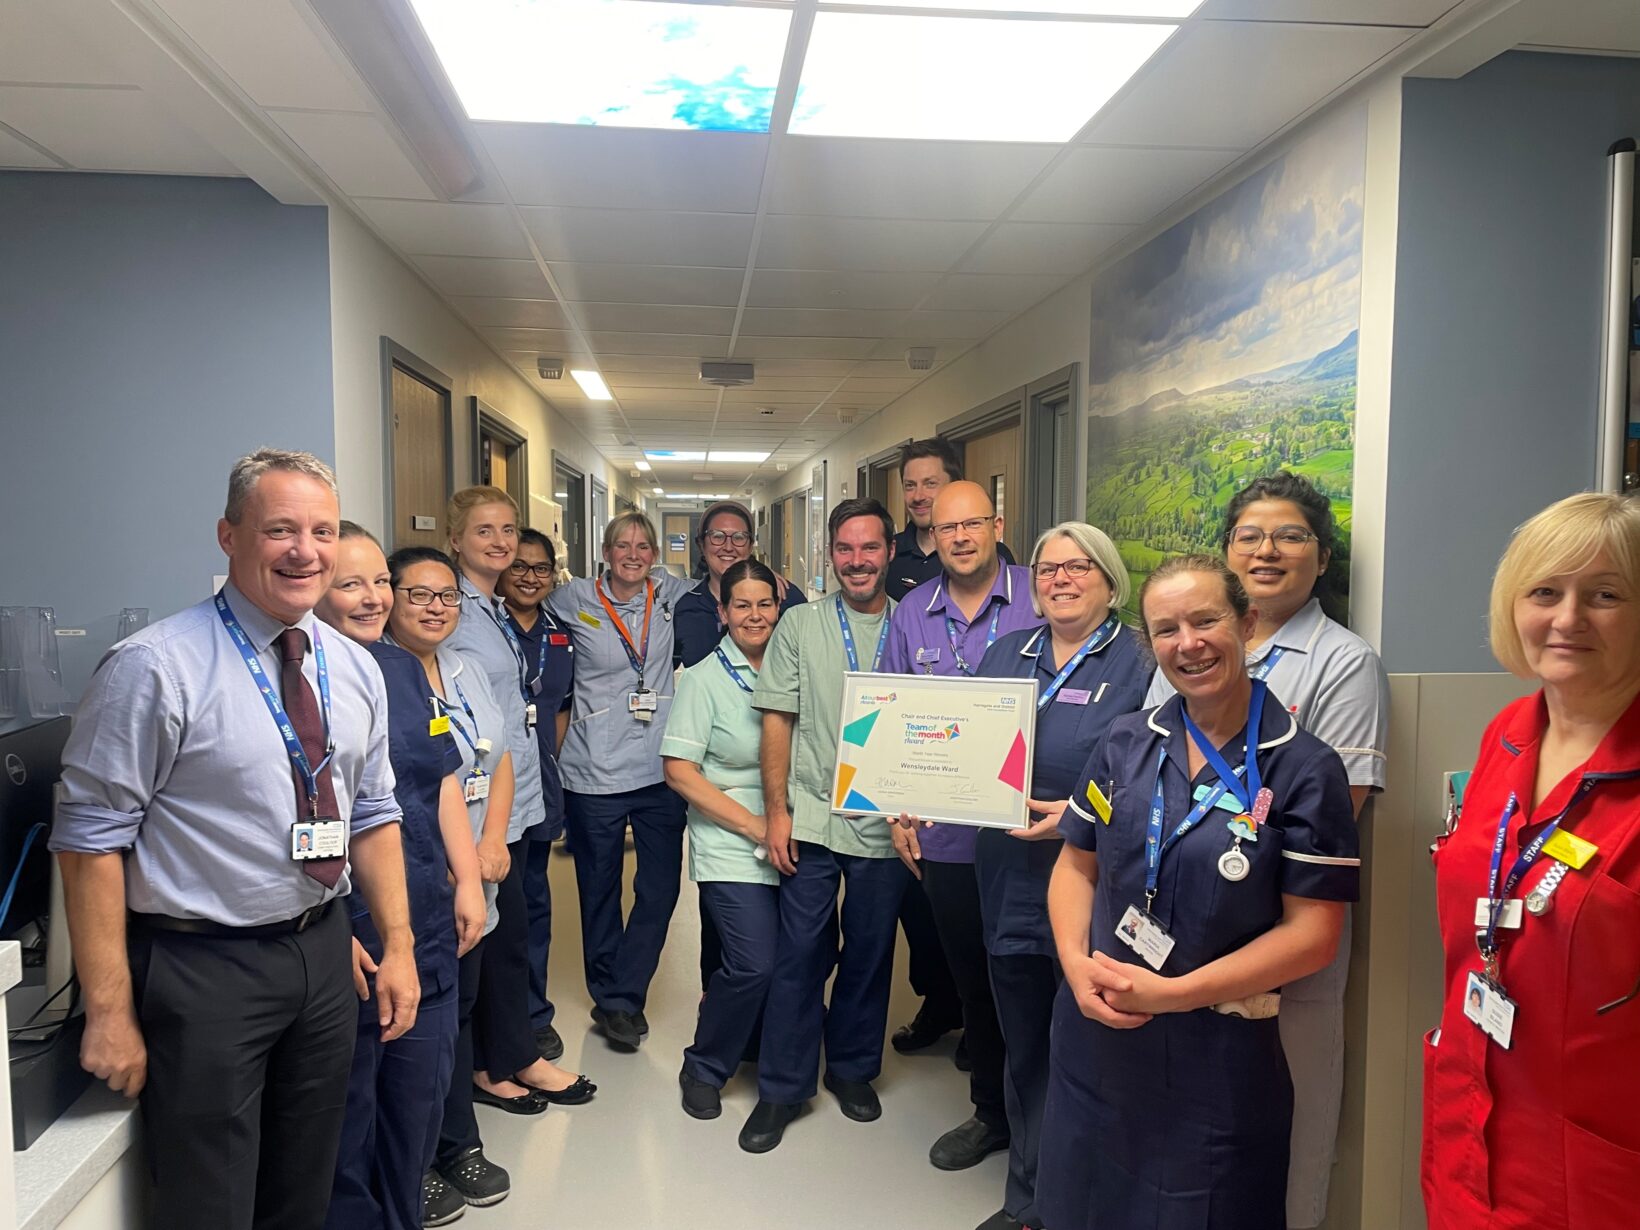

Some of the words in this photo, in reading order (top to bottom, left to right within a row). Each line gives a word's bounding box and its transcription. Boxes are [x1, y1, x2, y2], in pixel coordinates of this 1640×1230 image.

[247, 657, 262, 674] NHS
[281, 724, 295, 741] NHS
[905, 730, 918, 738] the
[918, 731, 945, 739] month
[906, 723, 928, 731] Team
[900, 762, 940, 772] Wensleydale
[1151, 808, 1161, 826] NHS
[1177, 820, 1191, 835] NHS
[1495, 827, 1505, 853] STAFF
[1523, 836, 1544, 862] STAFF
